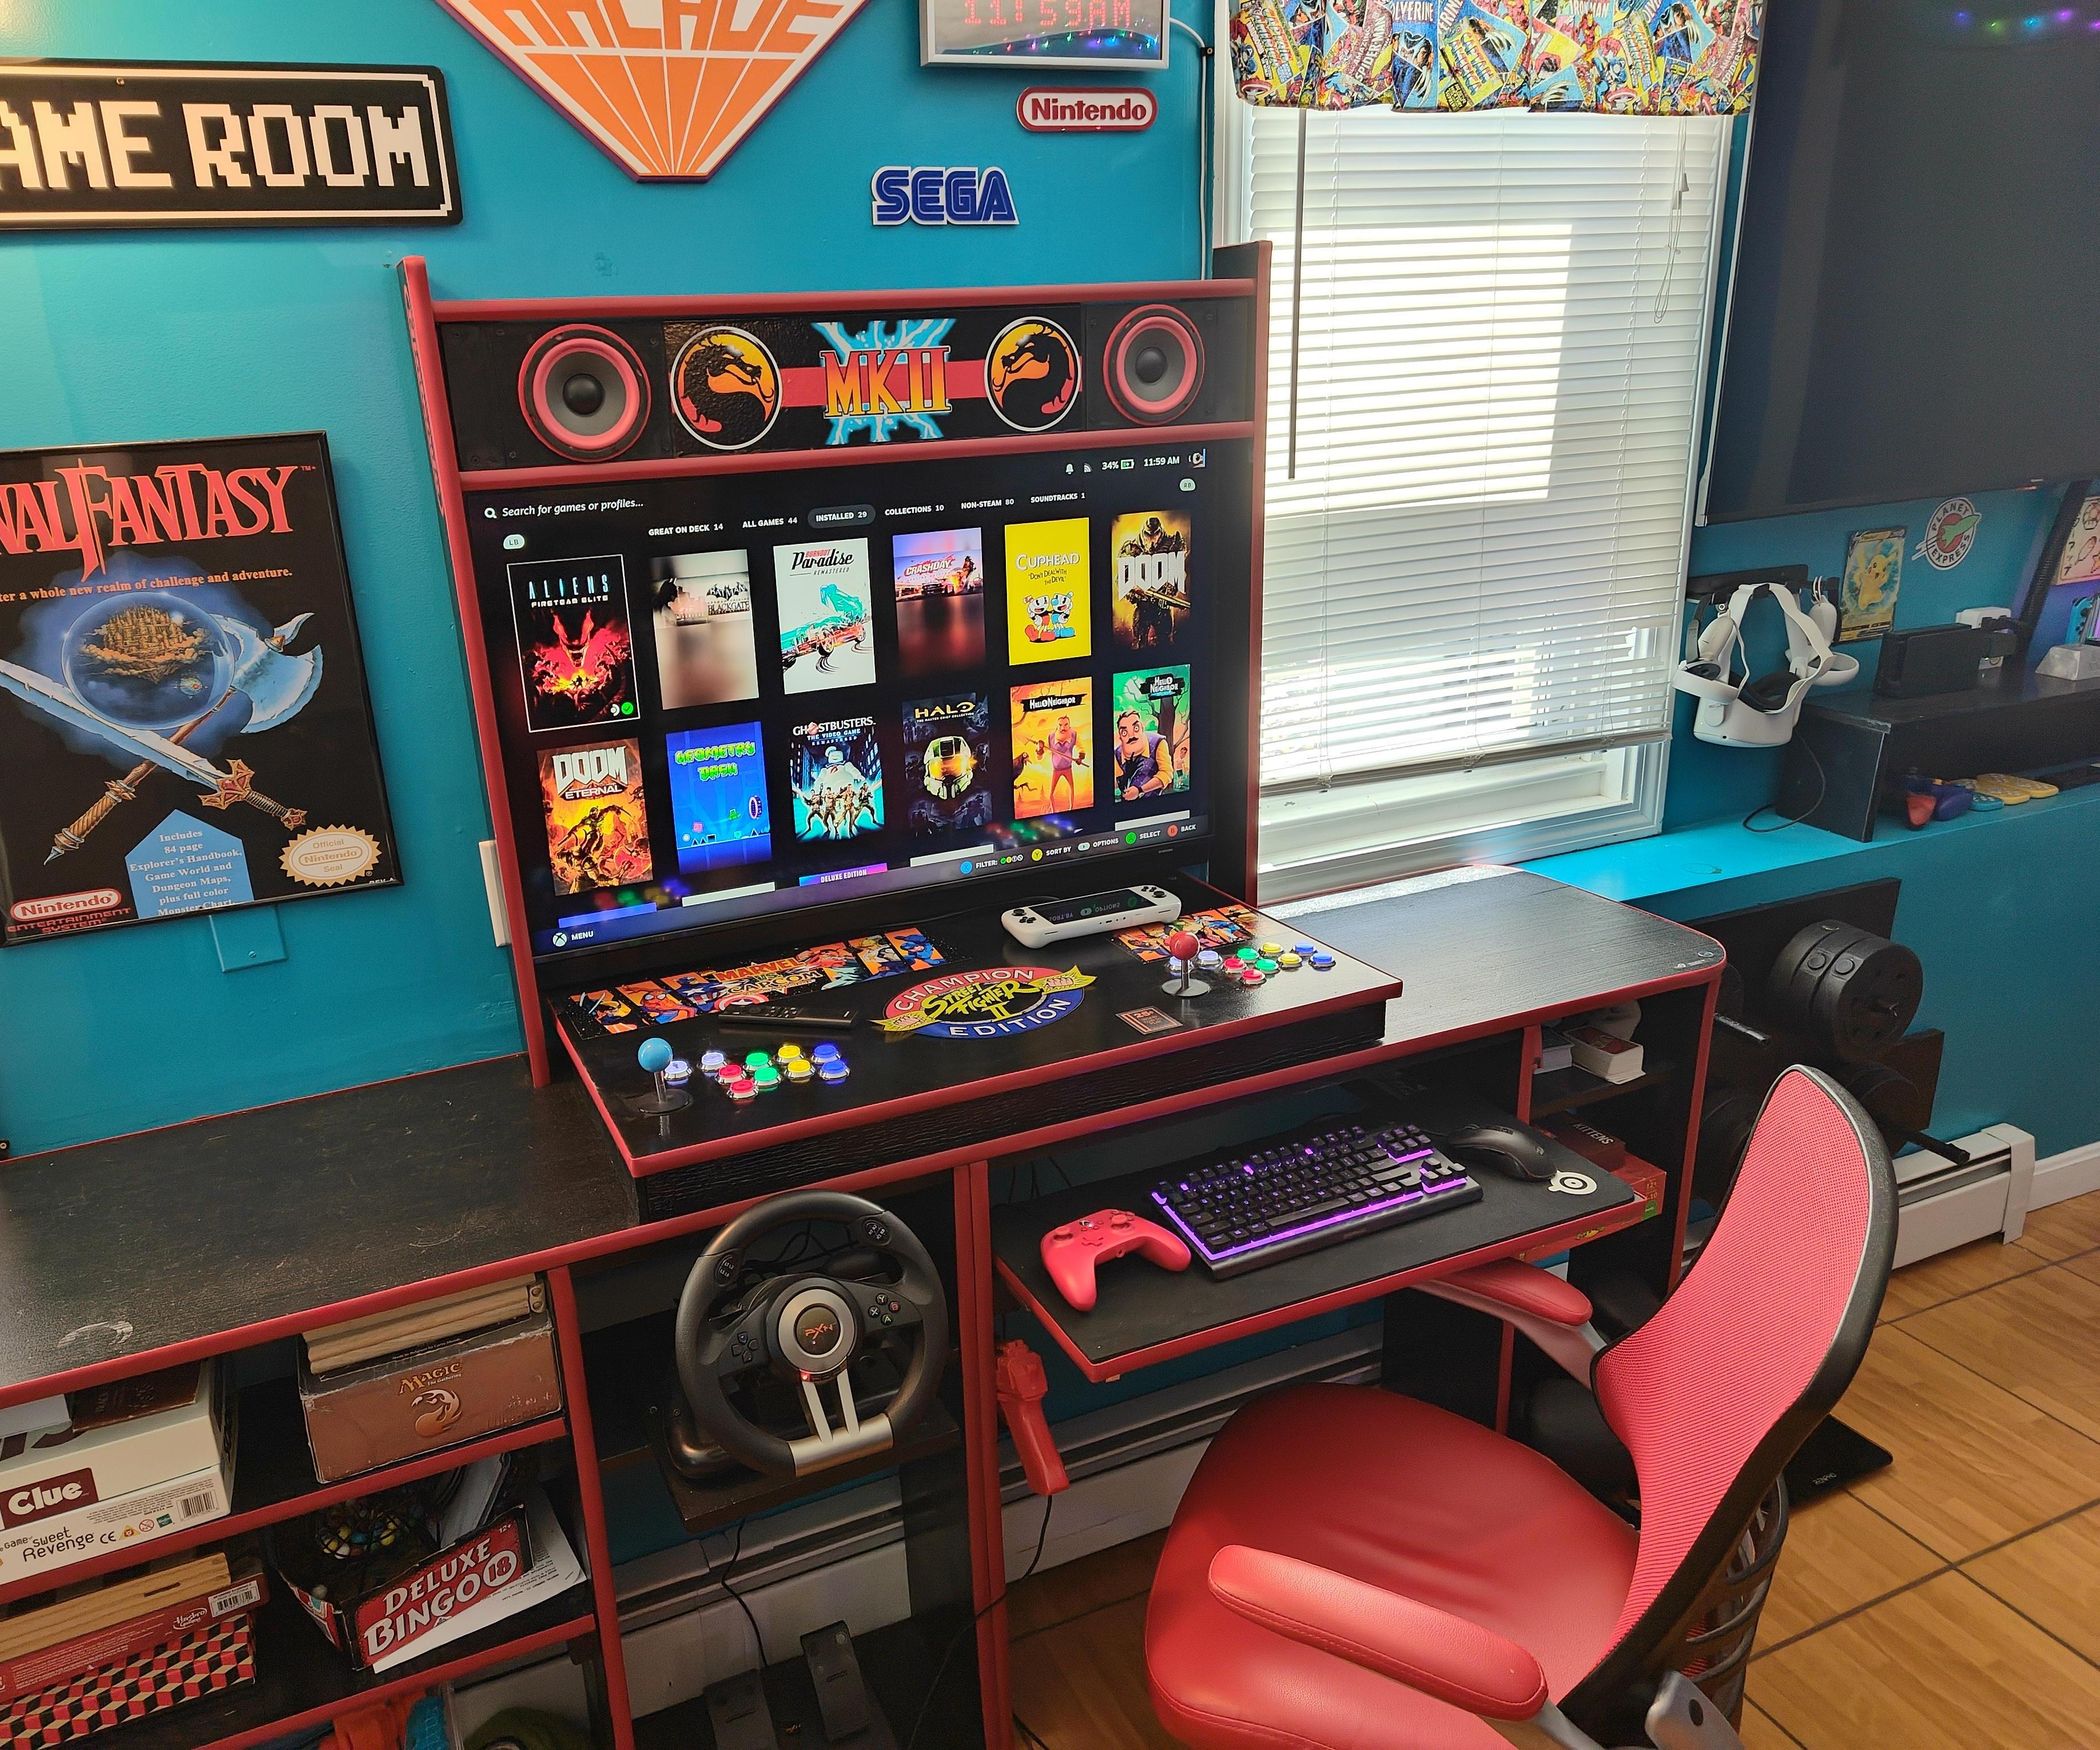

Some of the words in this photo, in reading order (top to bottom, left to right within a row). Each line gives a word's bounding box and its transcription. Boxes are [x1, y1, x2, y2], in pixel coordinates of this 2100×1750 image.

[1031, 97, 1147, 121] Nintendo
[0, 100, 173, 189] AME
[182, 103, 430, 189] ROOM
[874, 168, 1017, 223] SEGA
[1101, 461, 1119, 470] 34%
[1143, 457, 1166, 467] 11:59
[1167, 456, 1180, 465] AM
[502, 505, 536, 517] Search
[537, 504, 552, 517] for
[554, 503, 586, 515] games
[588, 502, 599, 511] or
[600, 498, 644, 512] profiles...
[961, 499, 1002, 510] NON-STEAM
[1005, 498, 1014, 506] 80
[1030, 493, 1078, 504] SOUNDTRACKS
[54, 457, 299, 582] FANTASY
[815, 512, 854, 522] INSTALLED
[857, 511, 867, 519] 29
[884, 505, 932, 516] COLLECTIONS
[935, 504, 944, 512] 10
[1931, 502, 1970, 532] PLANET
[648, 527, 673, 536] GREAT
[675, 525, 687, 534] ON
[688, 524, 710, 533] DECK
[713, 523, 723, 531] 14
[742, 520, 756, 528] ALL
[757, 518, 784, 527] GAMES
[1931, 534, 1970, 564] EXPRESS
[791, 548, 854, 570] Paradise
[904, 559, 953, 577] CRASHDAY
[1016, 552, 1080, 571] CUPHEAD
[30, 587, 66, 599] whole
[69, 586, 92, 596] new
[97, 581, 131, 593] realm
[135, 578, 147, 589] of
[150, 576, 205, 589] challenge
[207, 572, 229, 583] and
[232, 568, 293, 581] adventure.
[1117, 550, 1187, 601] DOOM
[528, 574, 609, 599] ALIENS
[914, 701, 976, 719] HALO
[821, 731, 841, 739] VIDEO
[843, 728, 861, 736] GAME
[552, 745, 628, 796] DOOM
[565, 785, 623, 800] ETERNAL
[160, 830, 203, 842] Includes
[1139, 830, 1161, 840] SELECT
[1180, 824, 1197, 833] BACK
[164, 845, 176, 854] 84
[179, 843, 204, 853] page
[312, 839, 345, 849] Official
[1045, 848, 1062, 856] SORT
[1092, 838, 1119, 848] OPTIONS
[129, 857, 185, 872] Explorer's
[304, 849, 358, 864] Nintendo
[975, 860, 998, 869] FILTER:
[145, 871, 175, 881] Game
[178, 865, 211, 876] World
[213, 862, 233, 871] and
[323, 863, 343, 873] Seal
[820, 873, 843, 883] DELUXE
[843, 869, 867, 879] EDITION
[152, 881, 197, 893] Dungeon
[200, 876, 231, 888] Maps,
[20, 894, 111, 917] Nintendo
[159, 894, 180, 906] plus
[183, 891, 201, 901] full
[203, 887, 229, 897] color
[7, 907, 131, 933] ENTERTAINMENT
[158, 905, 201, 916] Monster
[571, 931, 594, 941] MENU
[714, 957, 803, 982] MARVEL
[725, 969, 824, 995] CAPCOM
[896, 968, 1035, 1012] CHAMPION
[921, 981, 983, 1021] STREET
[945, 979, 1041, 1015] FIGHTER
[949, 998, 1072, 1036] EDITION
[982, 1001, 1023, 1023] II
[1573, 1122, 1614, 1145] KITTENS
[8, 1482, 83, 1516] Clue
[22, 1532, 95, 1563] Revenge
[383, 1537, 491, 1617] DELUXE
[363, 1573, 481, 1656] BINGO
[487, 1554, 512, 1584] 18
